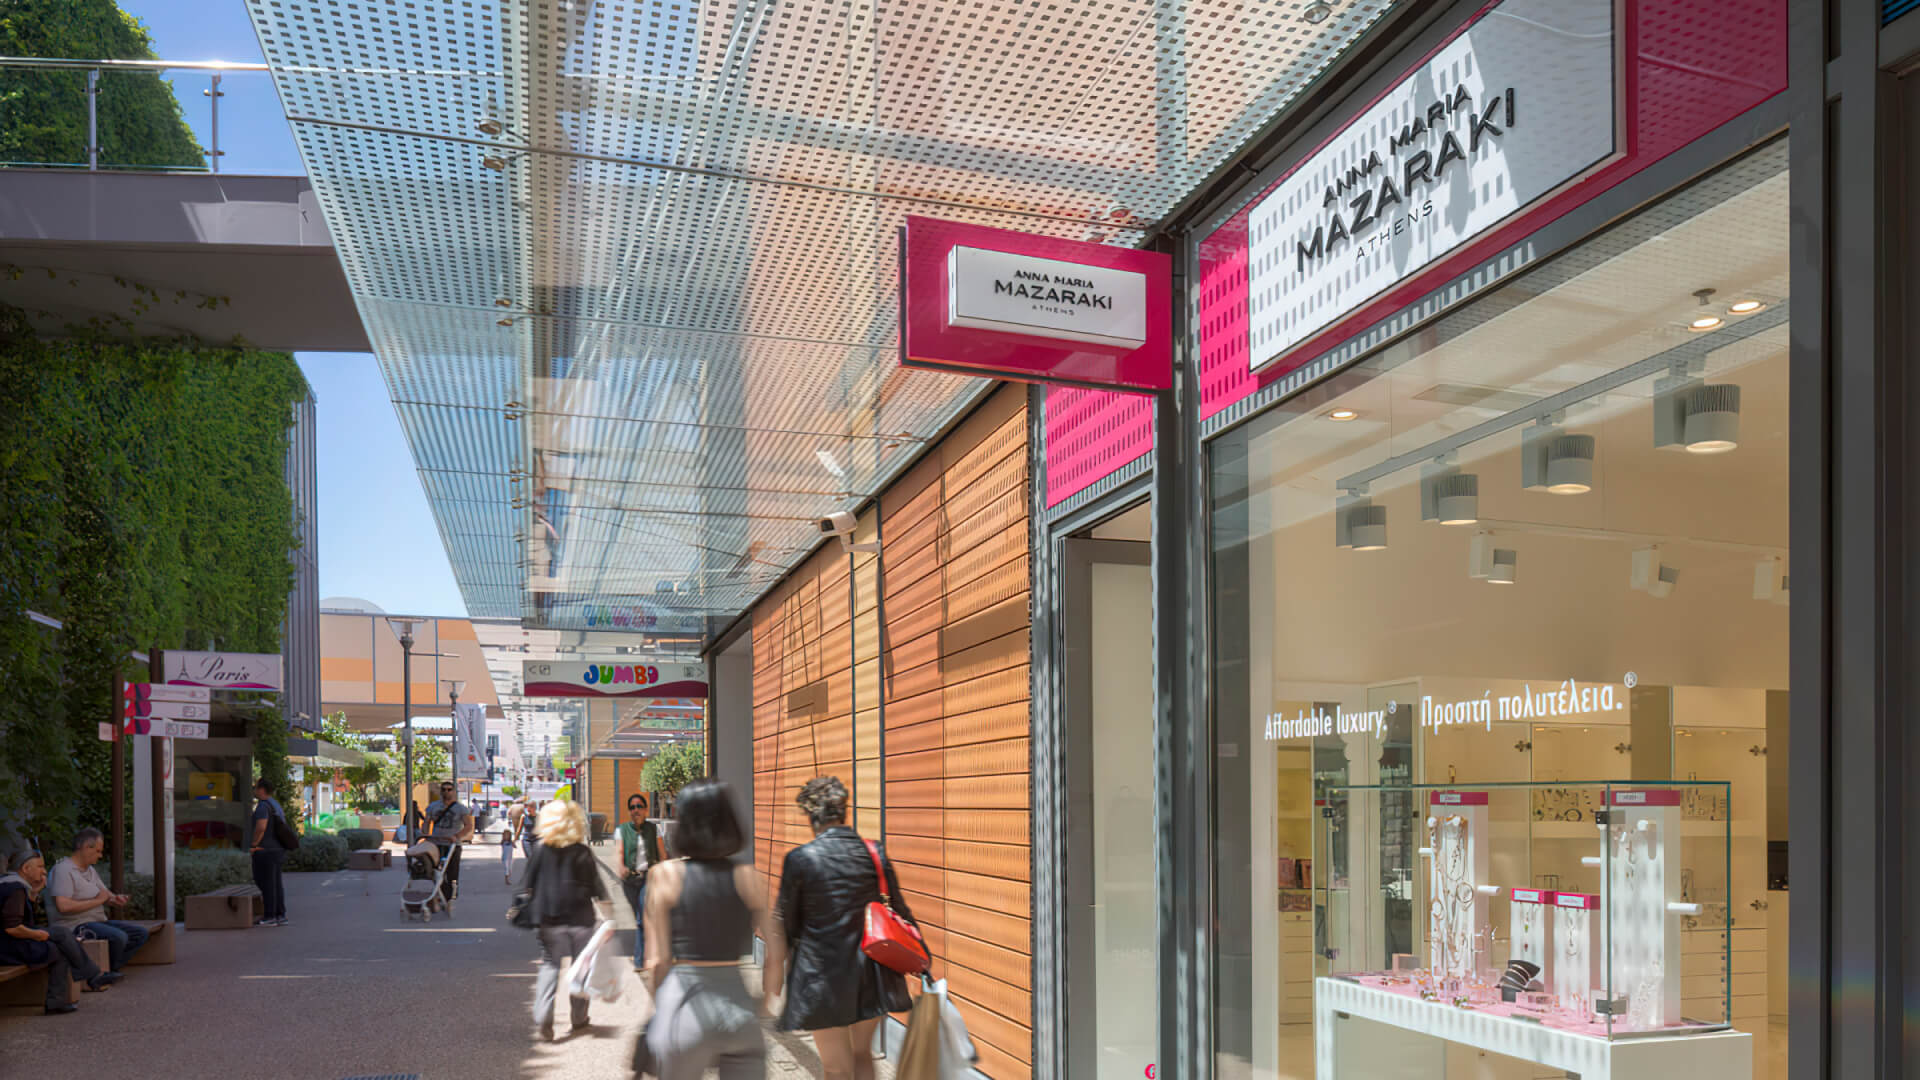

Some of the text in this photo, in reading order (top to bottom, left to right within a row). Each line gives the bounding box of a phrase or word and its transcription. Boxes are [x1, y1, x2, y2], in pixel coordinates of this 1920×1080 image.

[1322, 83, 1472, 208] ANNA MARIA
[1296, 87, 1515, 273] MAZARAKI
[1355, 199, 1434, 262] ATHENS
[993, 279, 1113, 310] MAZARAKI
[1014, 269, 1095, 289] ANNA MARIA
[1031, 304, 1075, 316] ATHENS
[199, 655, 251, 682] Paris
[583, 664, 659, 685] JUMBO
[1264, 706, 1332, 740] Affordable
[1421, 689, 1491, 736] Προσιτή
